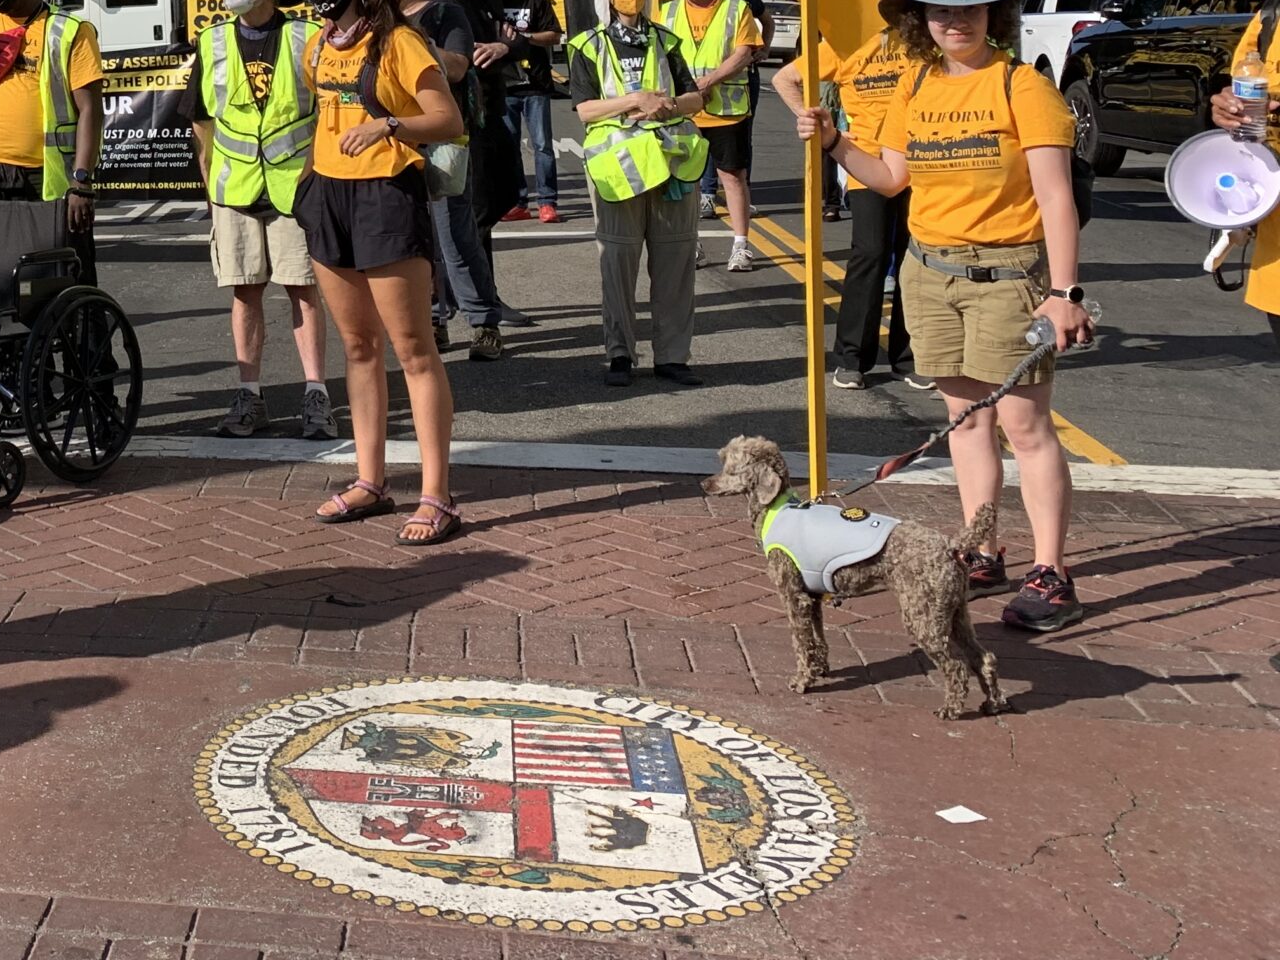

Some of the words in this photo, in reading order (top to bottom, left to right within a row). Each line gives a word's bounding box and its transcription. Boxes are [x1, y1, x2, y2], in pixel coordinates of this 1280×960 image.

[122, 53, 197, 69] ASSEMBLY
[101, 78, 111, 89] O
[115, 76, 142, 88] THE
[146, 74, 190, 87] POLLS
[102, 95, 134, 115] UR
[103, 129, 125, 139] UST
[127, 129, 144, 139] DO
[152, 142, 189, 150] Registering,
[914, 149, 950, 160] People's
[951, 145, 1000, 158] Campaign
[109, 152, 138, 160] Engaging
[153, 152, 194, 160] Empowering
[972, 159, 1001, 167] REVIVAL
[102, 162, 113, 170] for
[593, 695, 718, 733] CITY
[217, 696, 352, 790] FOUNDED
[715, 737, 783, 767] OF
[762, 773, 830, 822] LOS
[226, 803, 316, 858] 1781
[615, 832, 824, 916] ANGELES
